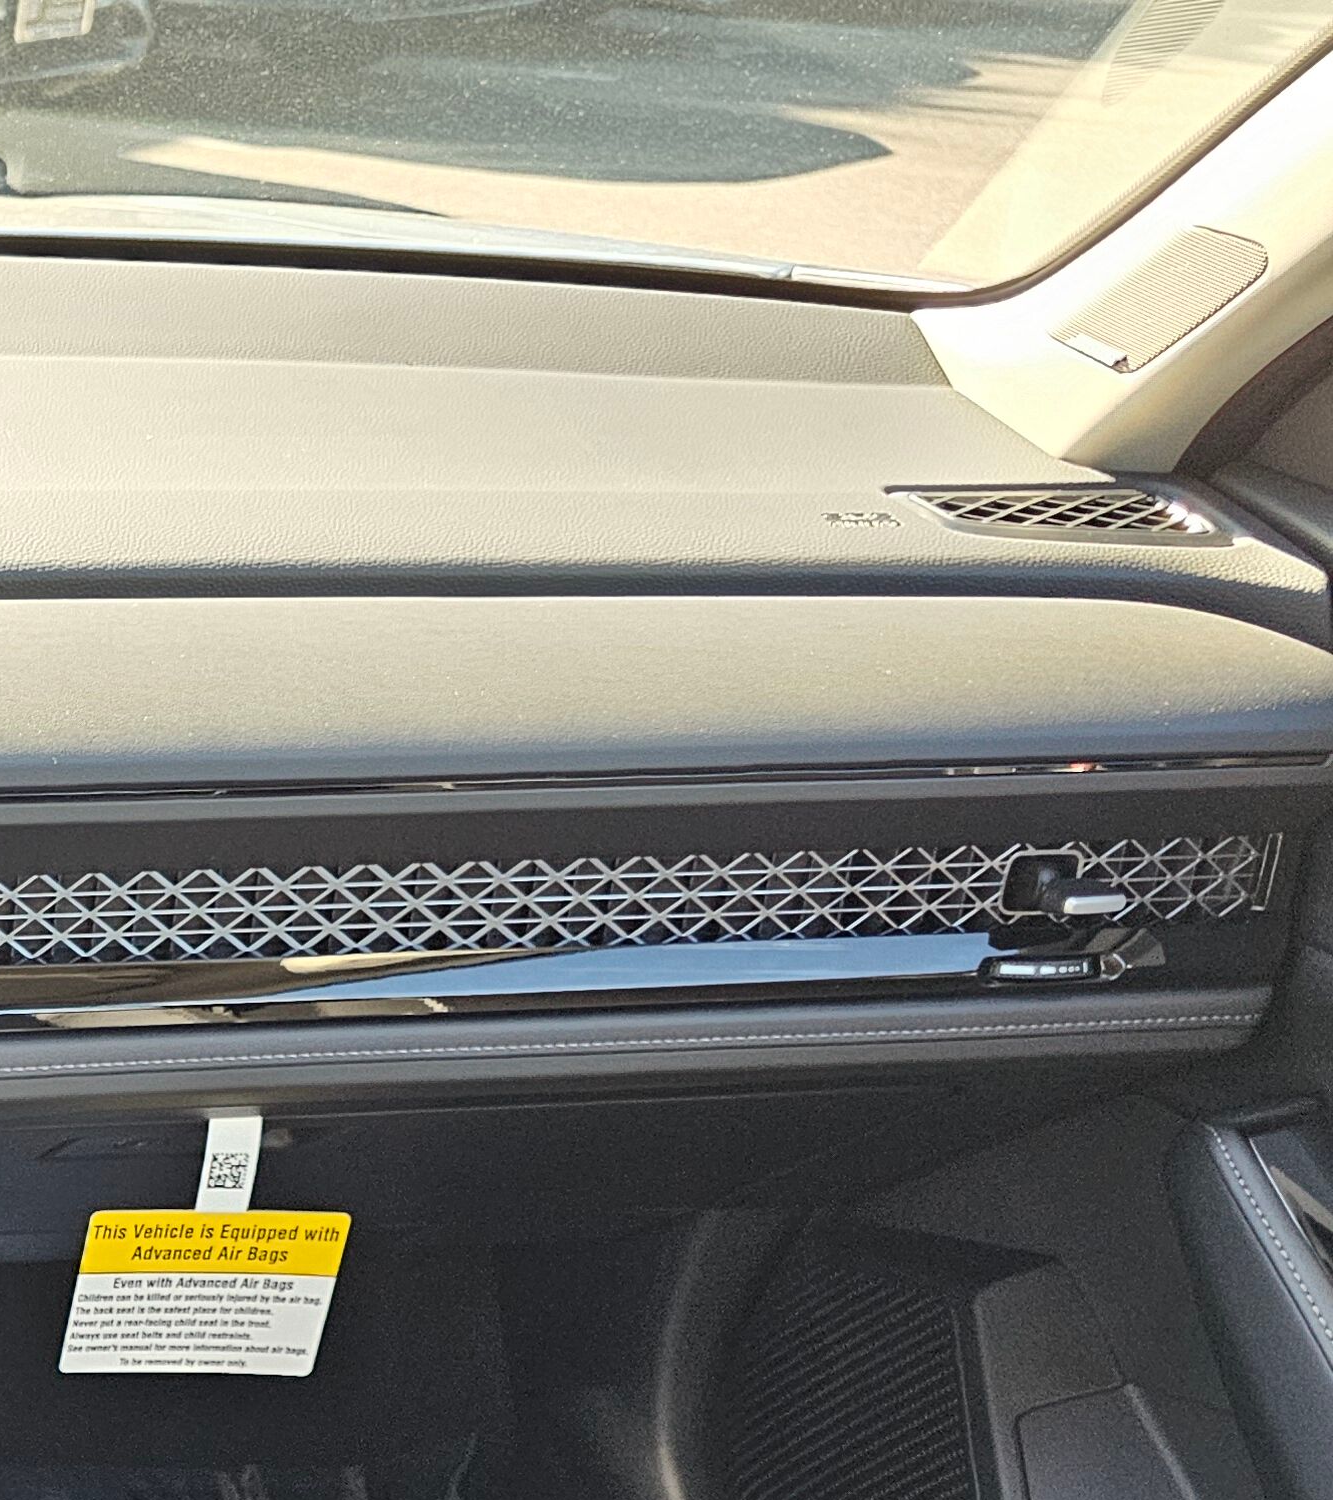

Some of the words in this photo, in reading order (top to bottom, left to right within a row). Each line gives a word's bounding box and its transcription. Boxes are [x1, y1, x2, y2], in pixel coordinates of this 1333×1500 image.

[94, 1224, 127, 1239] This
[134, 1223, 194, 1239] Vehicle
[200, 1224, 215, 1239] is
[220, 1224, 300, 1243] Equipped
[304, 1227, 340, 1242] with
[131, 1246, 213, 1261] Advanced
[217, 1247, 243, 1261] Air
[247, 1247, 289, 1265] Bags
[113, 1277, 142, 1289] Even
[147, 1277, 173, 1289] with
[175, 1278, 237, 1289] Advanced
[240, 1278, 260, 1289] Air
[263, 1279, 294, 1292] Bags
[78, 1294, 114, 1302] Children
[134, 1294, 144, 1302] be
[147, 1294, 171, 1302] killed
[185, 1294, 224, 1303] seriously
[226, 1294, 258, 1303] injured
[260, 1295, 270, 1304] by
[273, 1295, 286, 1303] the
[303, 1296, 322, 1306] bag.
